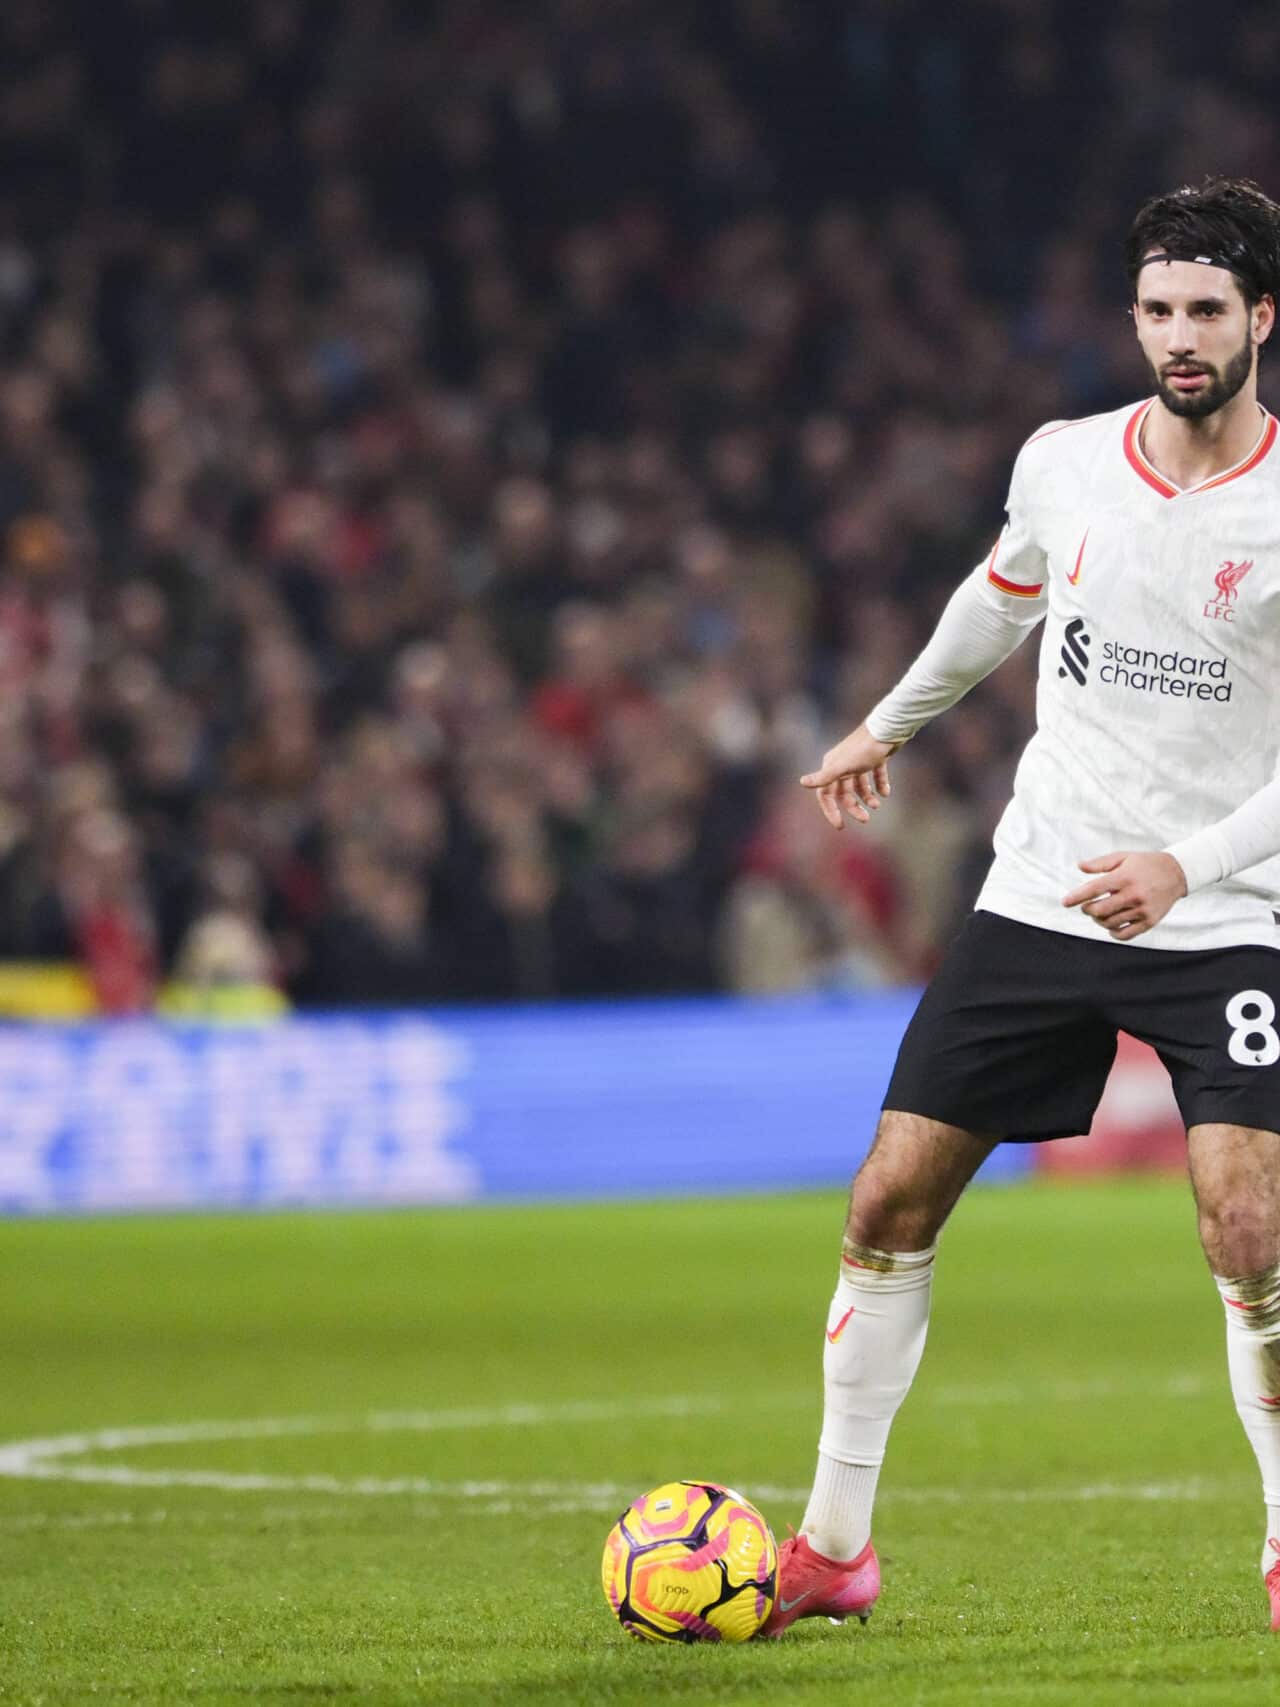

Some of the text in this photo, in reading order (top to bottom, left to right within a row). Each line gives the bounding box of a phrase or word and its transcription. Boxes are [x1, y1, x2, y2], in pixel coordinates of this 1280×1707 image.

[1103, 641, 1228, 679] standard
[1099, 664, 1233, 703] chartered
[1225, 989, 1280, 1067] 8
